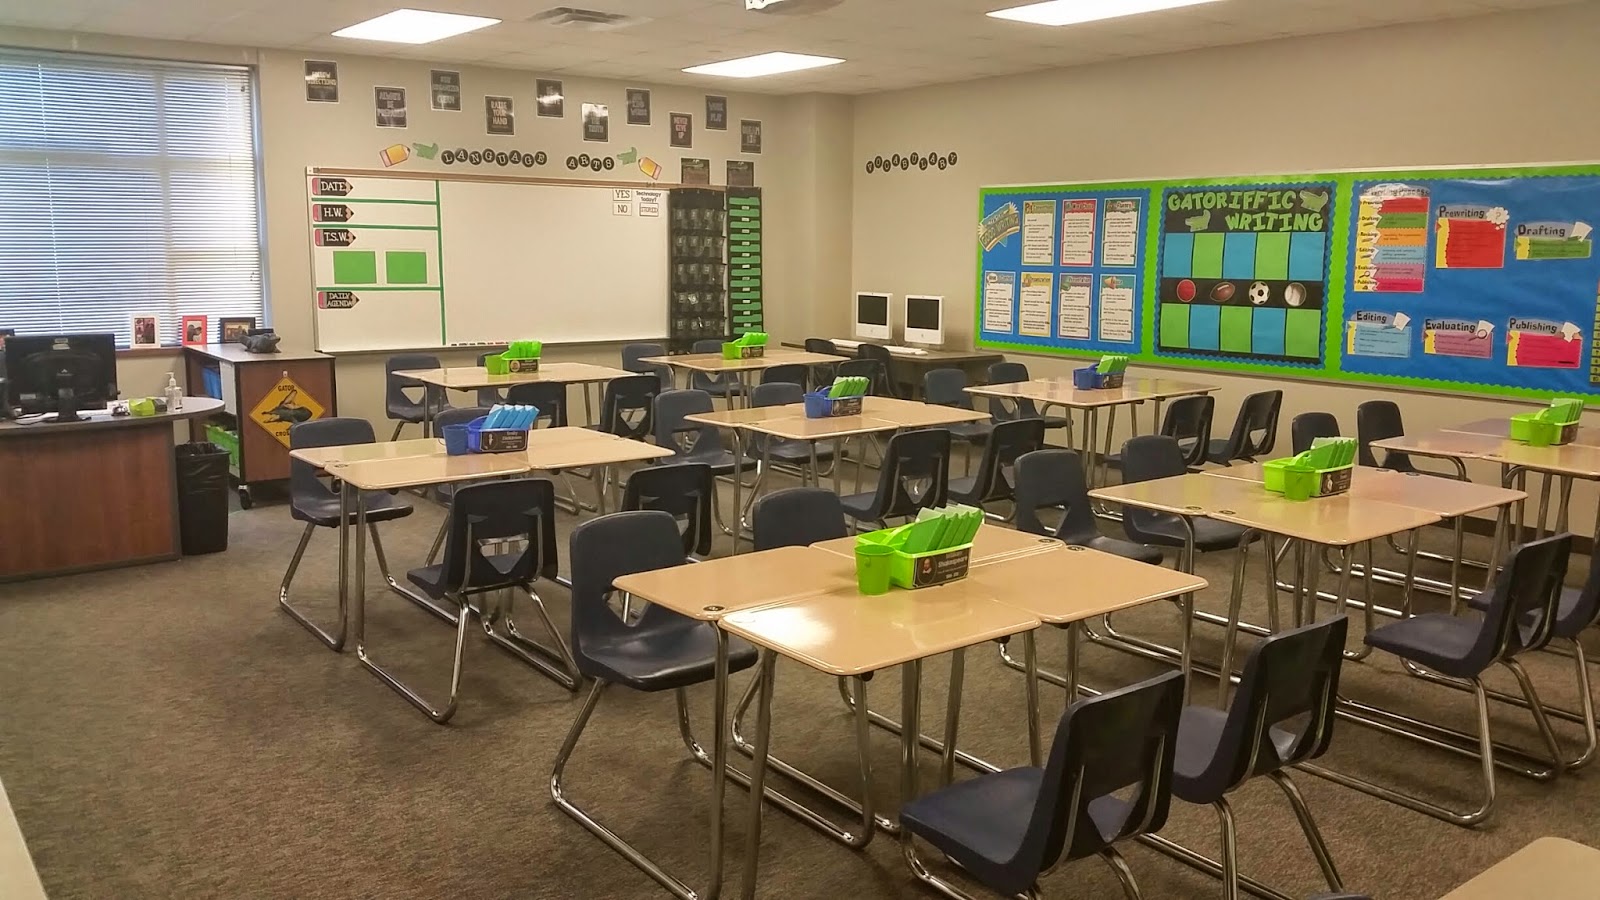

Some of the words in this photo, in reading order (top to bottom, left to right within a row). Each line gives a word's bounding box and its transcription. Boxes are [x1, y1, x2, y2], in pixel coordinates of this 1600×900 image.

[492, 116, 508, 125] HAND
[441, 148, 548, 168] LANGUAGE
[566, 153, 615, 172] ARTS
[865, 151, 958, 174] VOCABULARY
[321, 181, 346, 192] DATE
[615, 189, 631, 199] YES
[635, 190, 662, 198] Technology
[1167, 190, 1297, 211] GATORIFFIC
[323, 207, 343, 217] H.W.
[617, 204, 628, 213] NO
[1439, 205, 1485, 219] Prewriting
[1224, 212, 1324, 232] WRITING
[1517, 223, 1566, 237] Drafting
[326, 299, 353, 307] AGENDA
[328, 292, 351, 300] DAILY
[1356, 310, 1387, 324] Editing
[1425, 318, 1476, 333] Evaluating
[1509, 317, 1558, 334] Publishing
